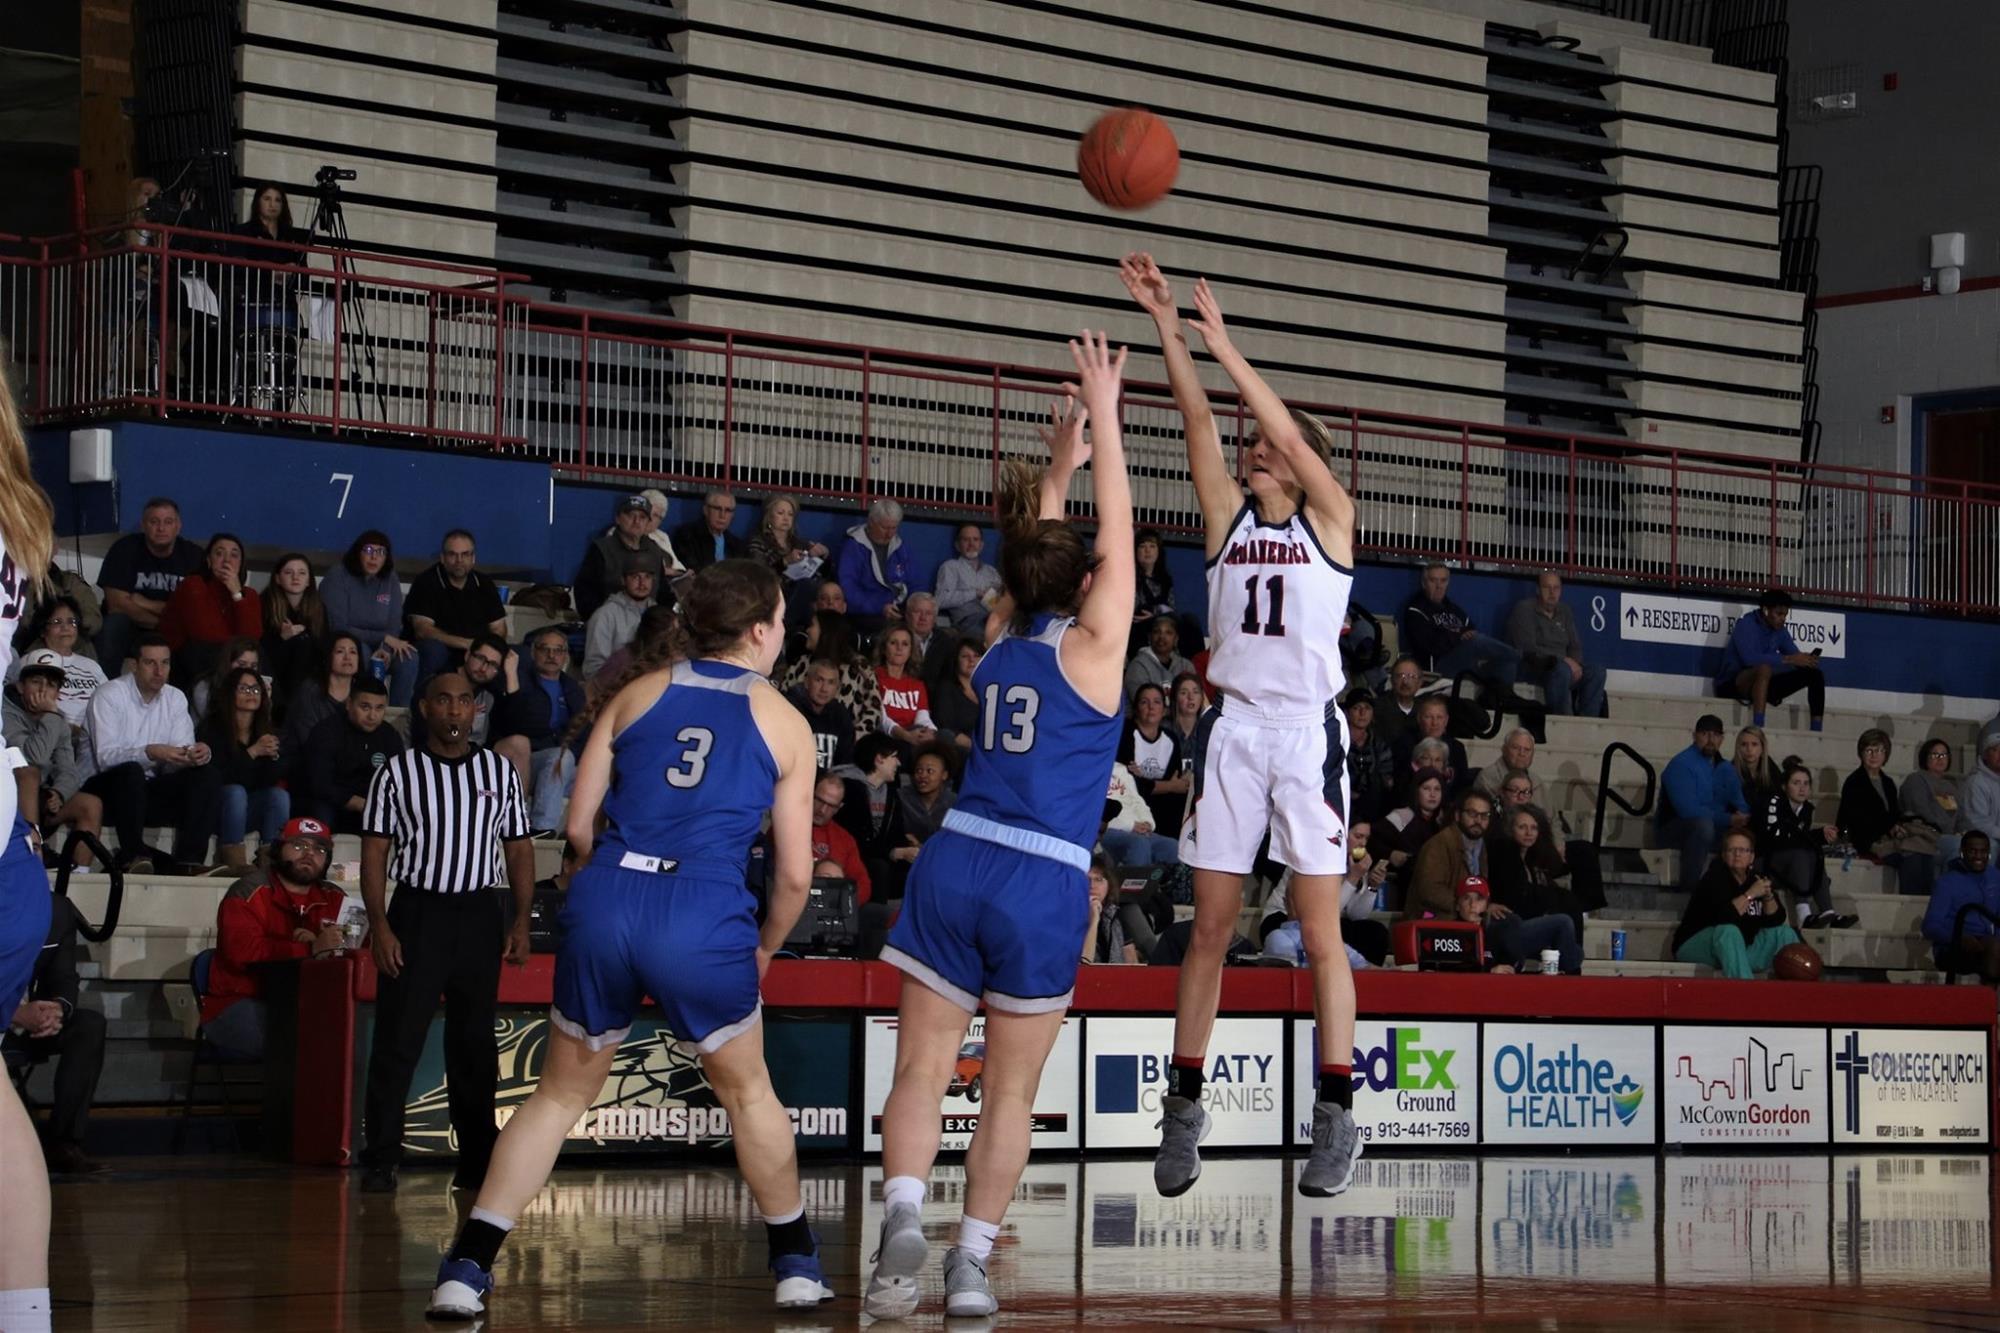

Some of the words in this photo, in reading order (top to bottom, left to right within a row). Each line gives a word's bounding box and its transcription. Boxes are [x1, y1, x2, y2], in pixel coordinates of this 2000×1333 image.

[329, 472, 354, 518] 7
[1241, 574, 1285, 636] 11
[1590, 595, 1606, 632] 8
[1642, 608, 1721, 634] RESERVED
[983, 682, 1041, 754] 13
[665, 726, 715, 789] 3
[1434, 938, 1463, 953] POSS.
[1142, 1054, 1274, 1083] BATY
[1494, 1043, 1614, 1094] Olathe
[1141, 1087, 1274, 1113] CPANIES
[1396, 1089, 1456, 1112] Ground
[1891, 1085, 1906, 1101] the
[1911, 1083, 1958, 1103] NAZARENE
[1508, 1096, 1610, 1128] HEALTH
[1378, 1122, 1470, 1138] 913-441-7569
[1699, 1128, 1791, 1137] CONSTRUCTION
